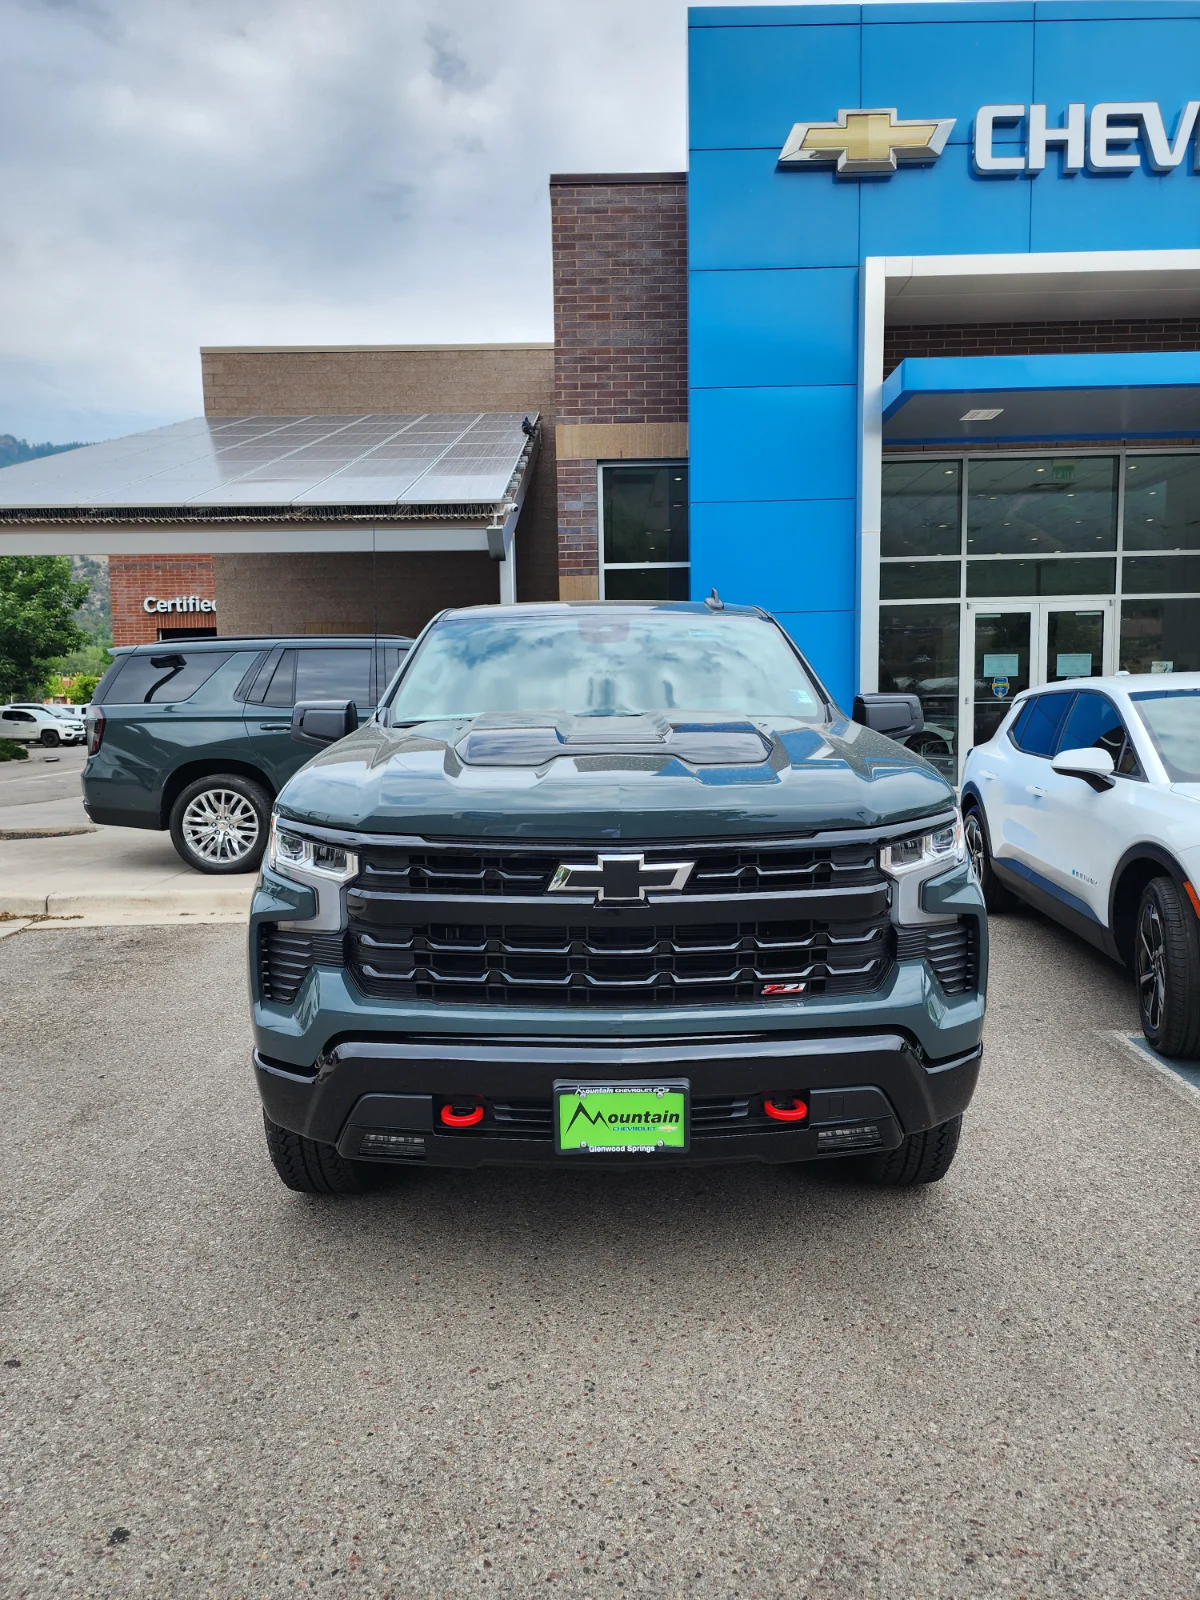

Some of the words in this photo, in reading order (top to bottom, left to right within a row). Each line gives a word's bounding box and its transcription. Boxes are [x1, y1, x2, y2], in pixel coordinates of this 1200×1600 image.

[973, 101, 1200, 173] CHEV
[761, 983, 806, 995] Z71
[574, 1085, 614, 1096] Mountain
[564, 1101, 679, 1137] Mountain
[589, 1145, 626, 1153] Glenwood
[627, 1145, 655, 1153] Springs
